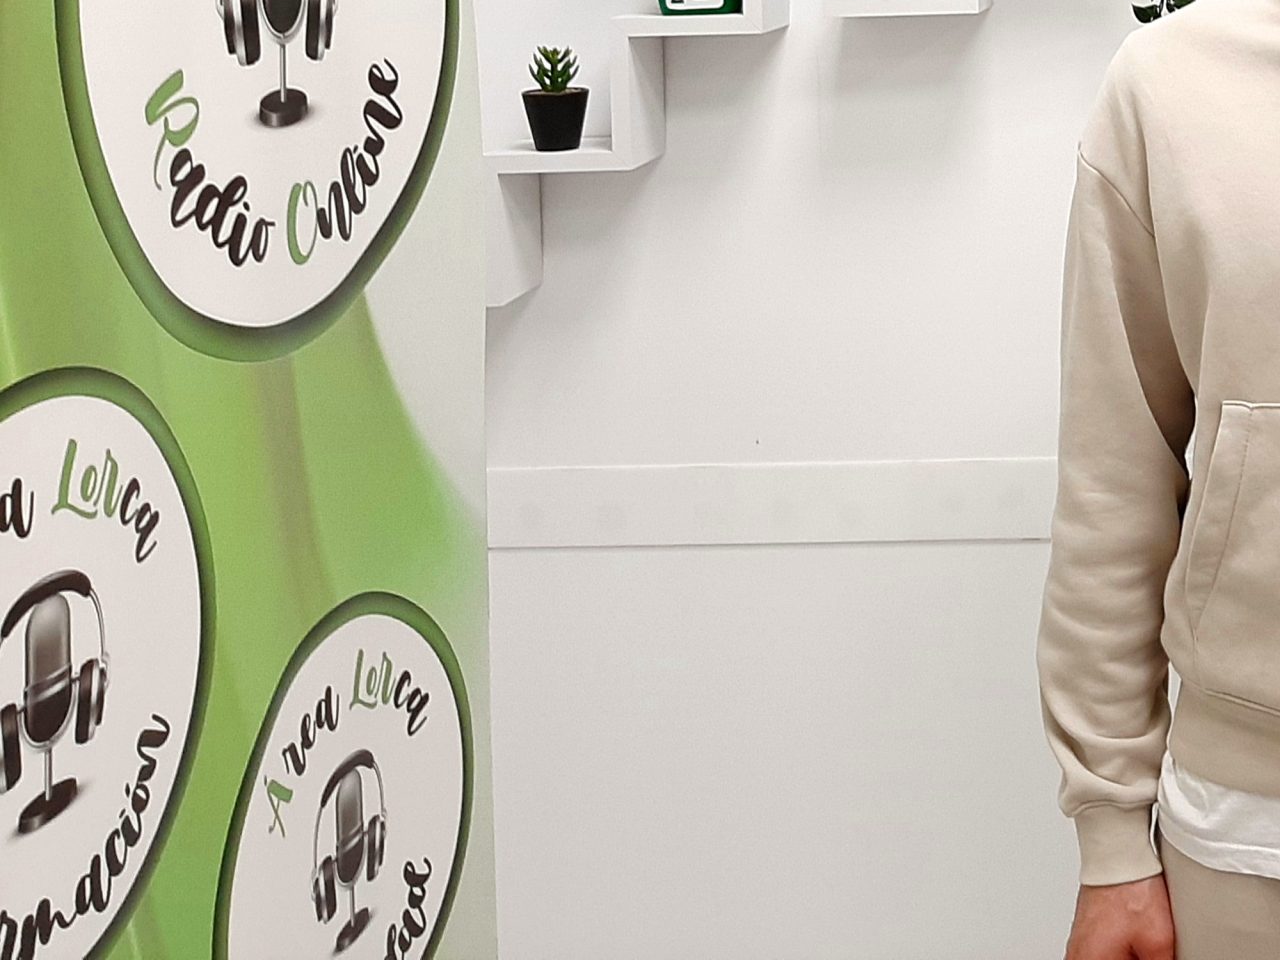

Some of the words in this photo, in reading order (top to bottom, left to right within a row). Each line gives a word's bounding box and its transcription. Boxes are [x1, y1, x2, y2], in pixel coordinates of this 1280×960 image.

[144, 69, 275, 267] Radio
[287, 58, 401, 265] Online
[51, 438, 160, 563] Lorca
[264, 685, 340, 838] Área
[349, 648, 430, 737] Lorca
